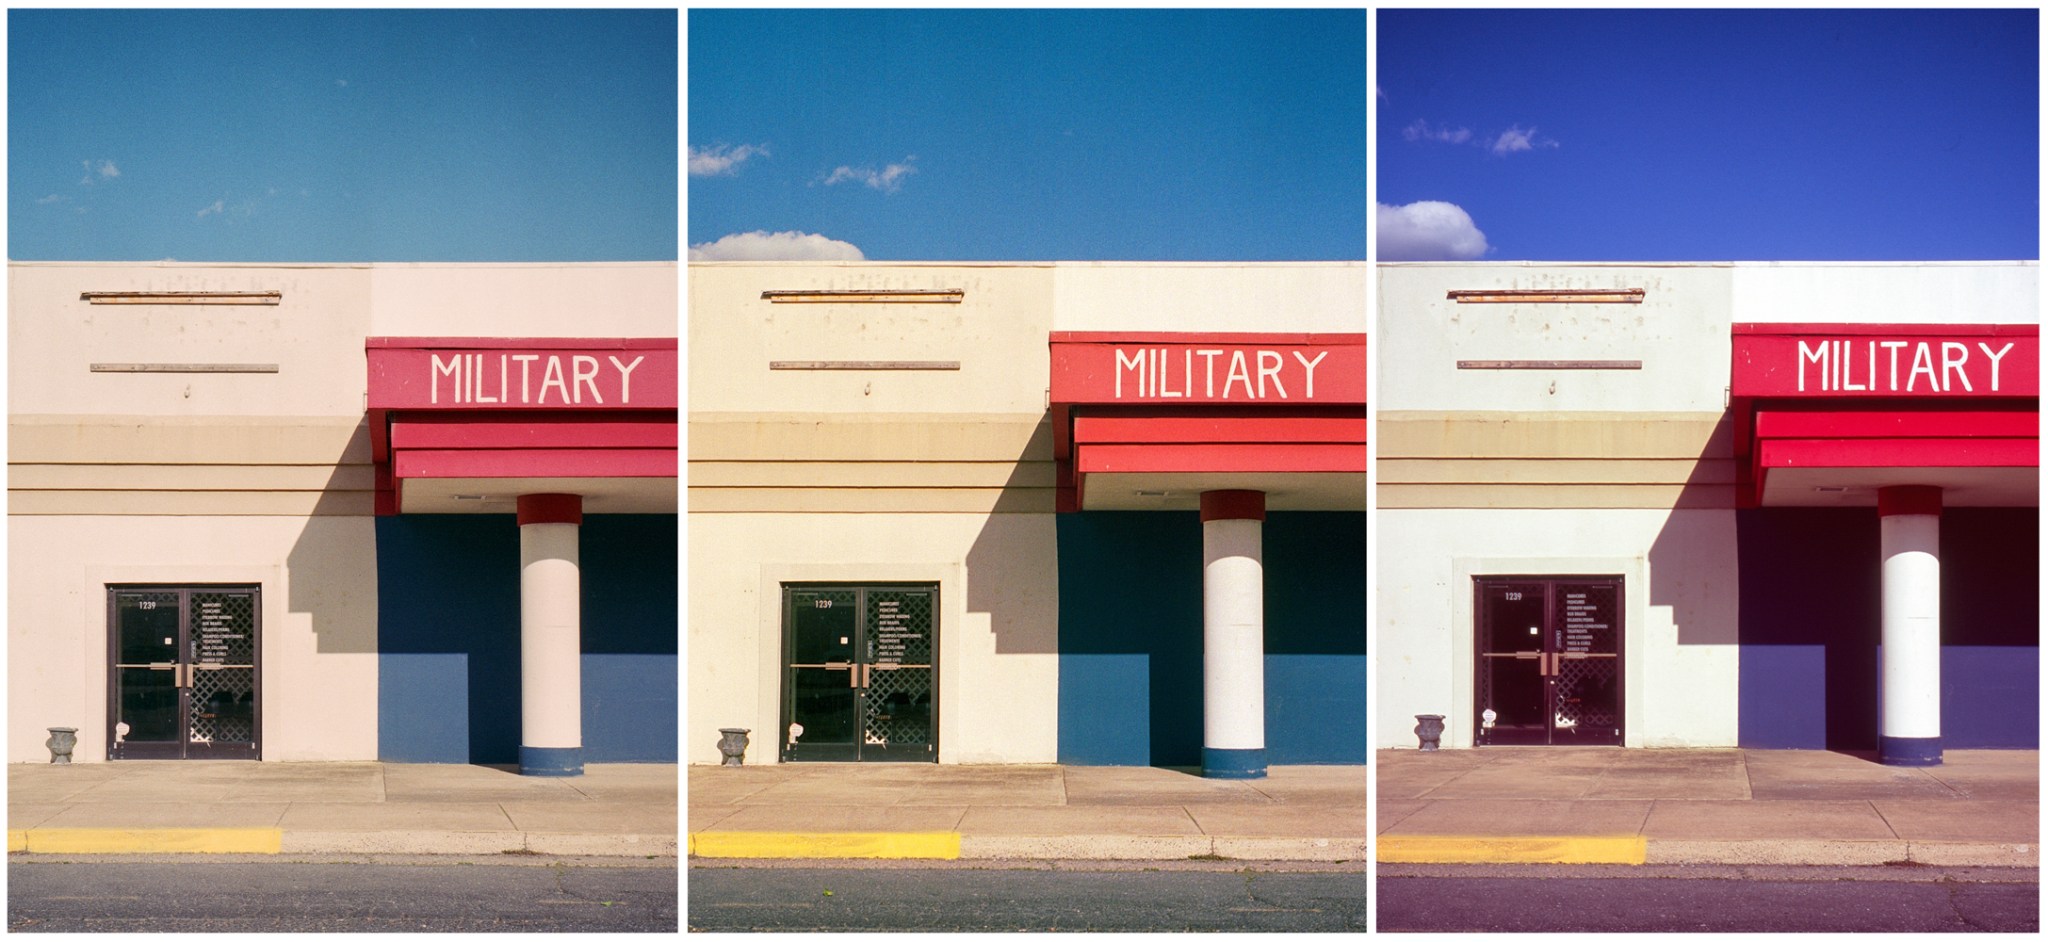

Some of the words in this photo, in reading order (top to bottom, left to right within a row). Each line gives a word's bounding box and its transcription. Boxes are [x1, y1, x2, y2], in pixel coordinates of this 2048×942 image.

[431, 353, 645, 404] MILITARY
[1115, 348, 1328, 399] MILITARY
[1798, 340, 2015, 392] MILITARY
[139, 601, 156, 610] 1239
[815, 600, 833, 608] 1239
[1505, 592, 1522, 600] 1239
